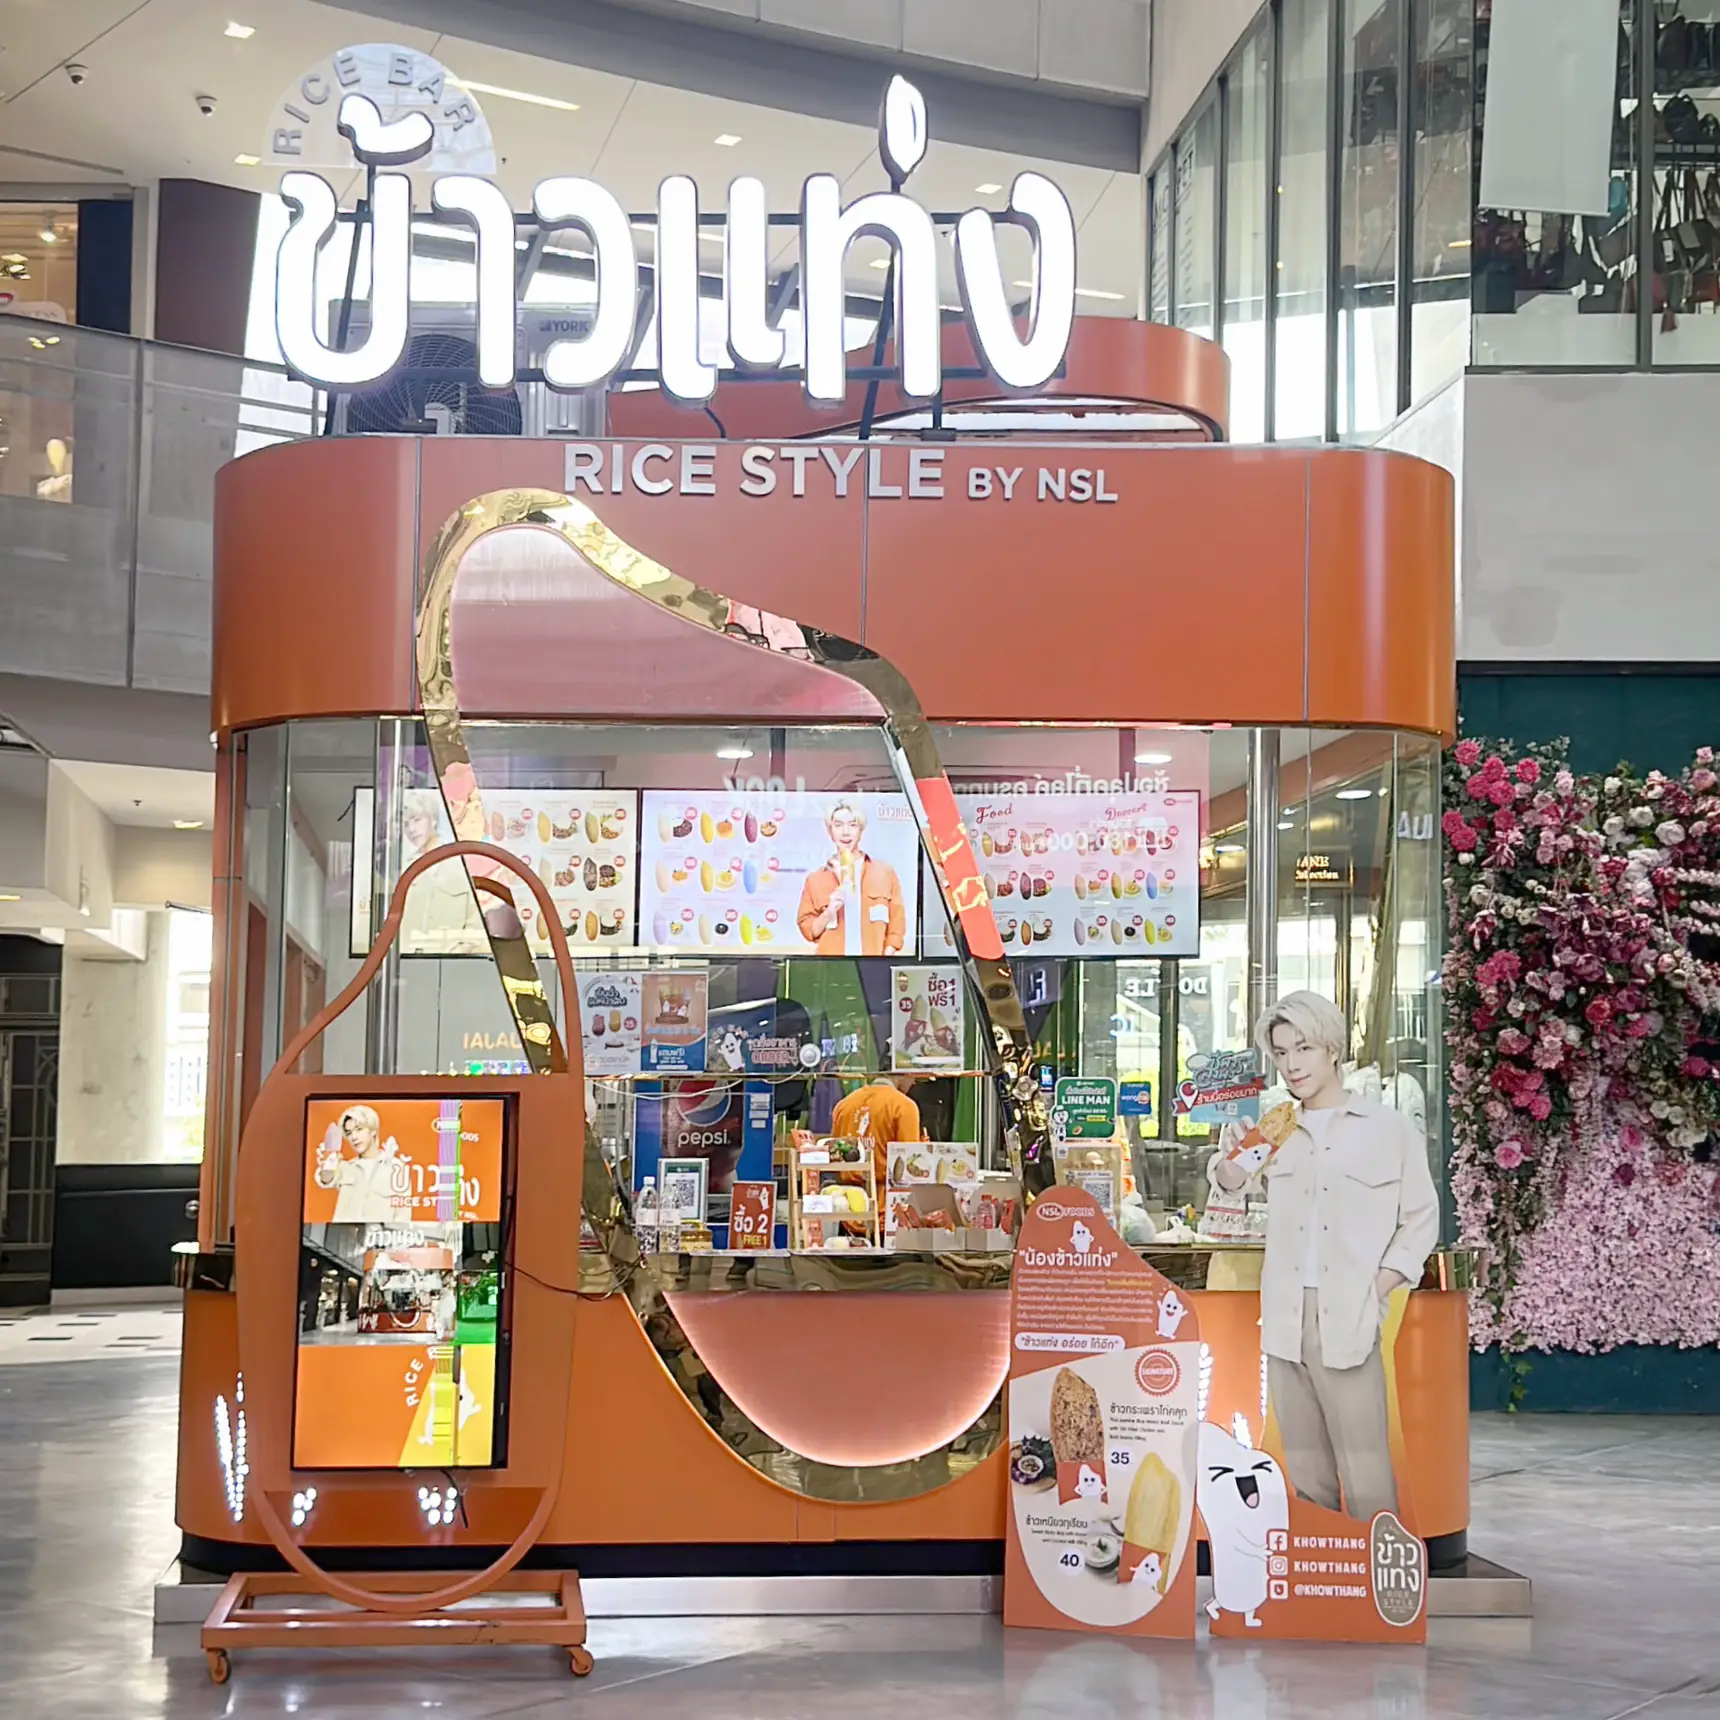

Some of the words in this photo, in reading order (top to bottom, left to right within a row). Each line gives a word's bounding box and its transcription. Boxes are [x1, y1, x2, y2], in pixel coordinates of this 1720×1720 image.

[273, 51, 362, 156] RICE
[388, 52, 476, 132] BAR
[275, 74, 1077, 404] ข้าวแท่ง
[552, 320, 589, 332] YORK
[563, 443, 717, 496] RICE
[740, 447, 945, 499] STYLE
[967, 467, 1023, 500] BY
[1036, 468, 1118, 503] NSL
[976, 803, 1013, 824] Food
[1061, 1095, 1085, 1105] LINE
[1086, 1095, 1111, 1105] MAN
[678, 1129, 728, 1148] pepsi
[391, 1196, 420, 1208] RICE
[1041, 1206, 1061, 1217] NSL
[756, 1213, 769, 1235] 2
[743, 1234, 762, 1246] FREE
[404, 1358, 424, 1407] RICE
[1110, 1452, 1130, 1464] 35
[1293, 1536, 1366, 1549] KHOWTHANG
[1060, 1554, 1080, 1566] 40
[1293, 1560, 1366, 1574] KHOWTHANG
[1294, 1584, 1367, 1598] @KHOWTHANG
